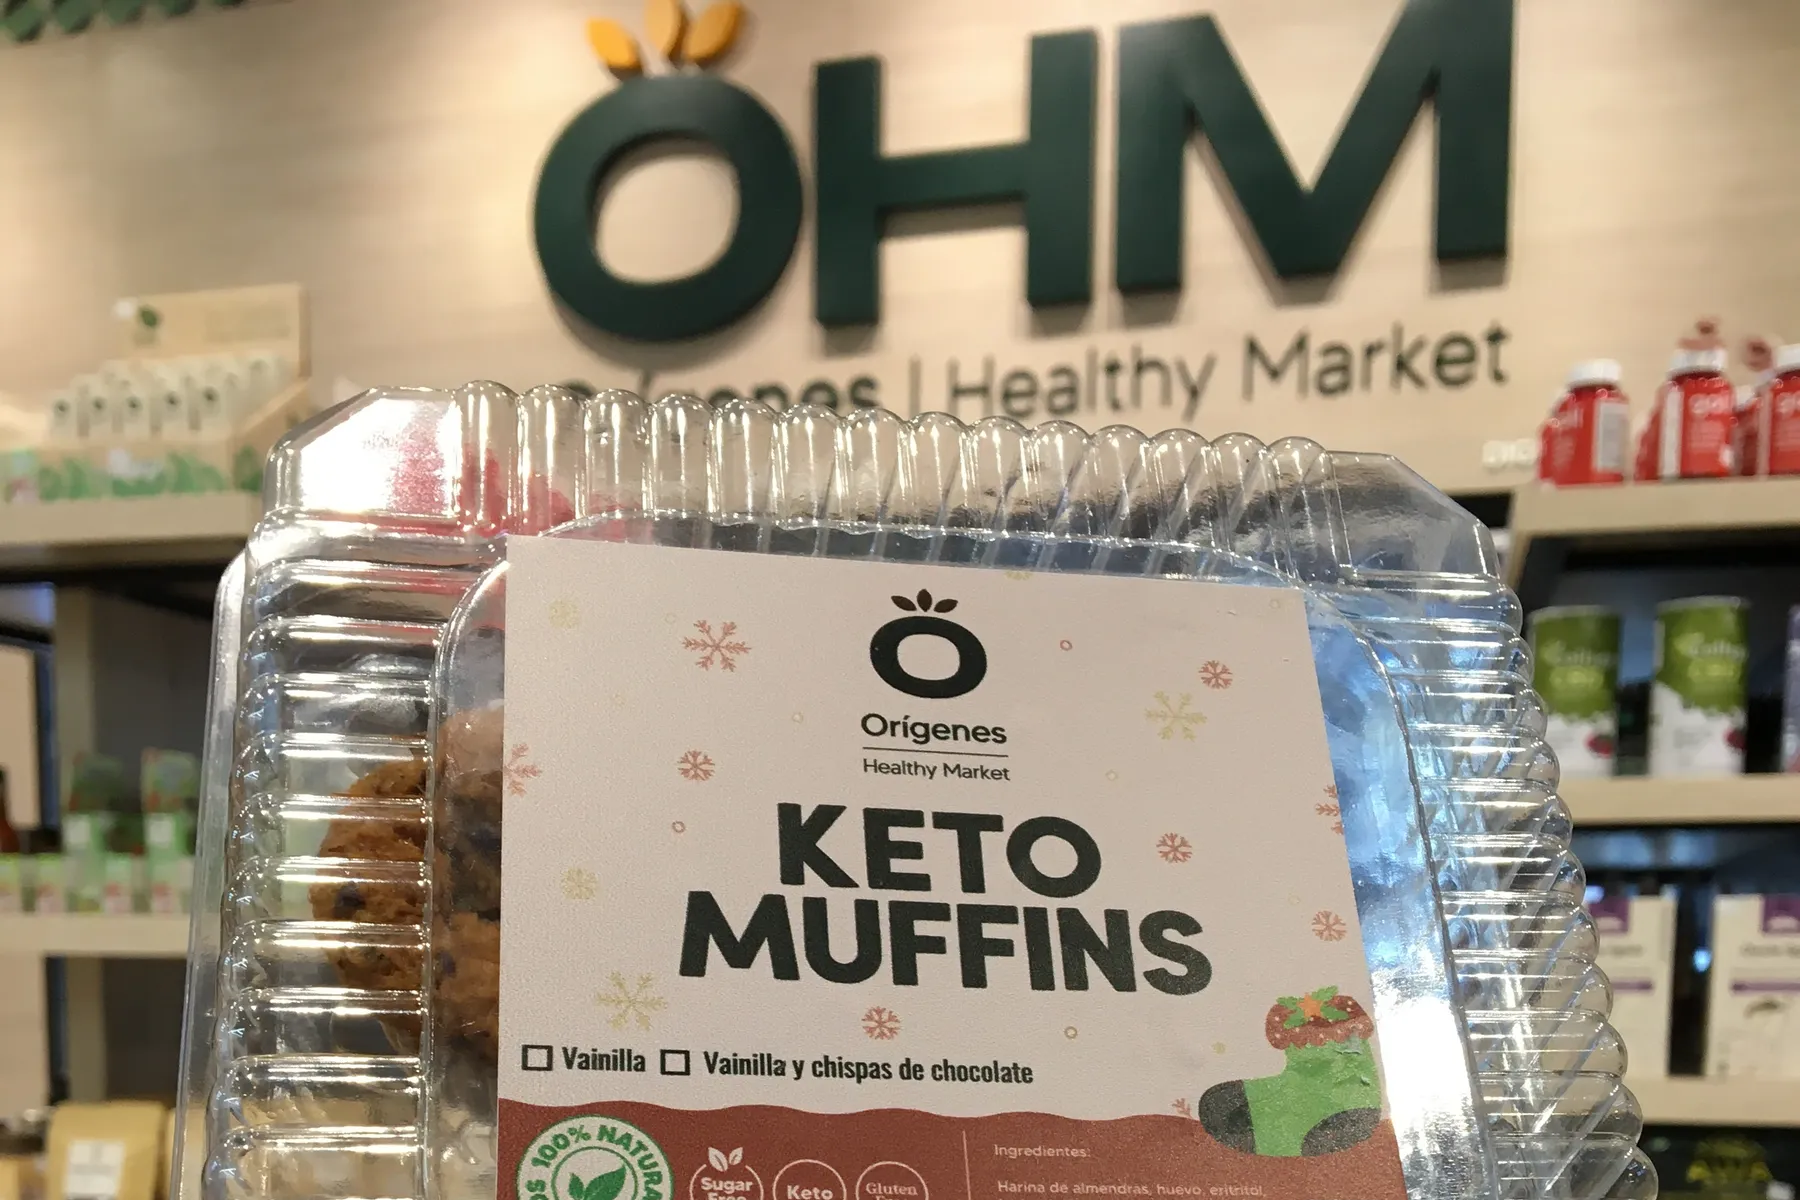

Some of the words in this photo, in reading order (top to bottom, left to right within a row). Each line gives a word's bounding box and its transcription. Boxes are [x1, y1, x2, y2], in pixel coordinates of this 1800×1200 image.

[948, 344, 1216, 423] Healthy
[1243, 320, 1512, 402] Market
[861, 712, 1008, 745] Orígenes
[862, 758, 937, 780] Healthy
[943, 760, 1011, 781] Market
[777, 802, 1102, 899] KETO
[679, 890, 1212, 996] MUFFINS
[562, 1046, 646, 1072] Vainilla
[704, 1051, 786, 1077] Vainilla
[792, 1059, 805, 1080] y
[811, 1055, 893, 1084] chispas
[899, 1057, 925, 1080] de
[931, 1058, 1034, 1084] chocolate
[531, 1124, 592, 1169] 100%
[994, 1144, 1091, 1159] Ingredientes:
[700, 1177, 753, 1195] Sugar
[787, 1185, 833, 1200] Keto
[865, 1182, 918, 1196] Gluten
[997, 1180, 1045, 1194] Harina
[1049, 1181, 1068, 1194] de
